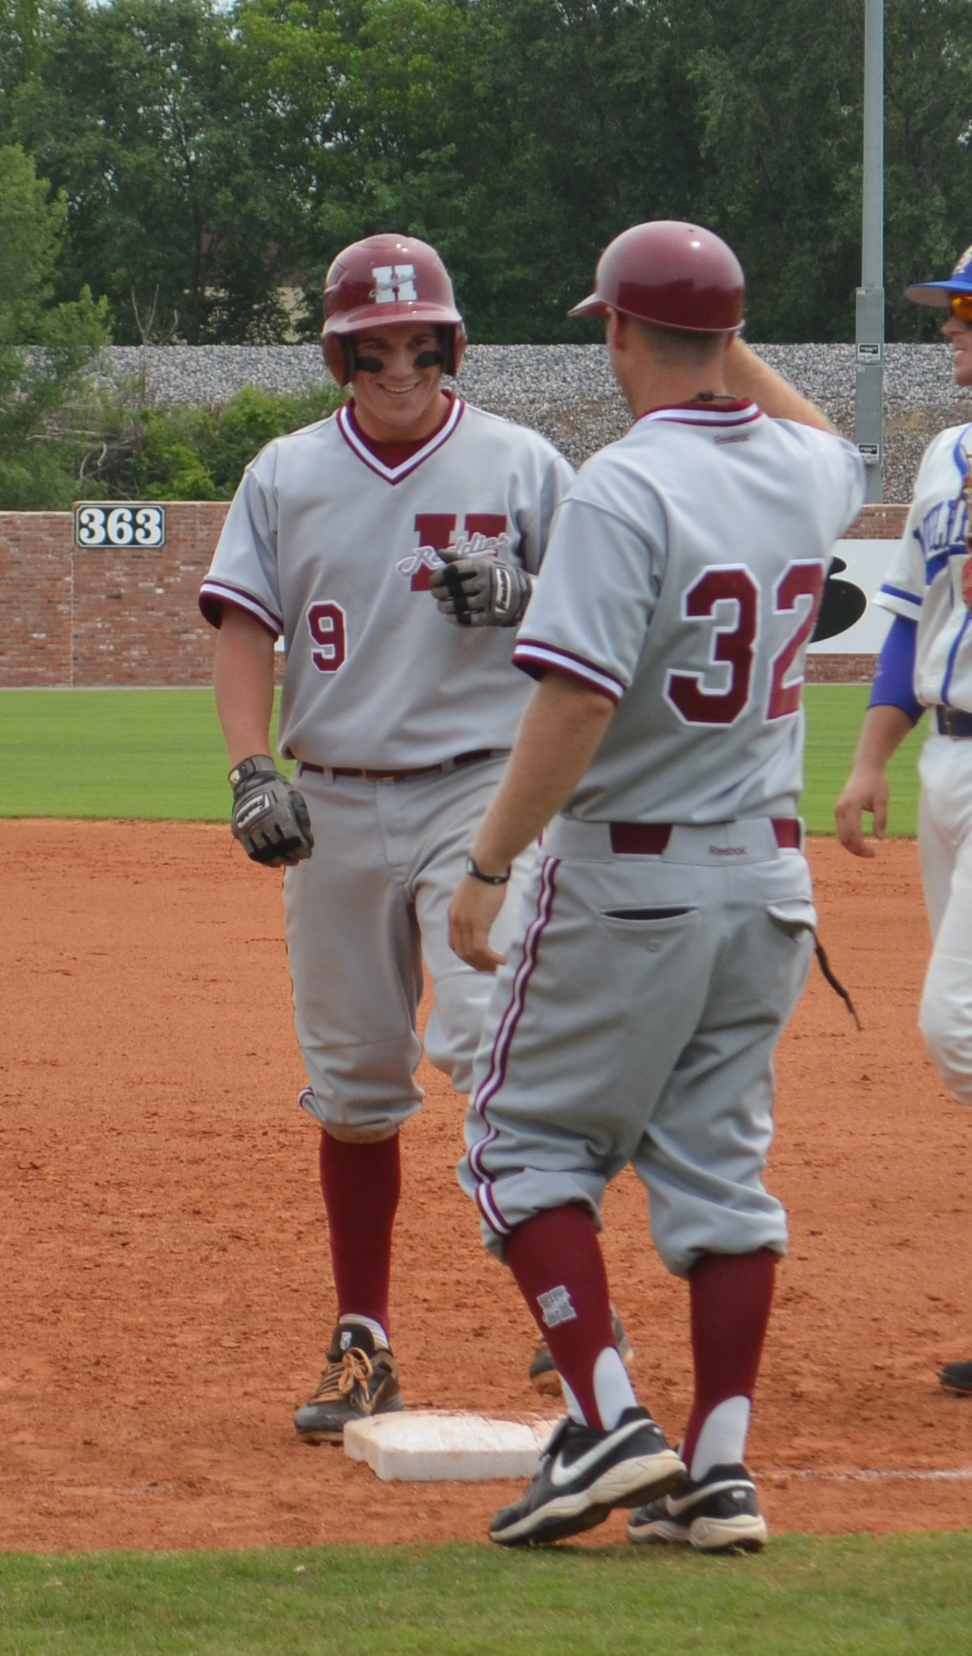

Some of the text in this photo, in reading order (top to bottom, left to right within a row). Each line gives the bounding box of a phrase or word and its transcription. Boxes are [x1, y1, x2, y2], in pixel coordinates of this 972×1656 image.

[372, 264, 417, 304] H
[79, 507, 162, 545] 363
[305, 600, 348, 674] 9
[663, 558, 826, 728] 32
